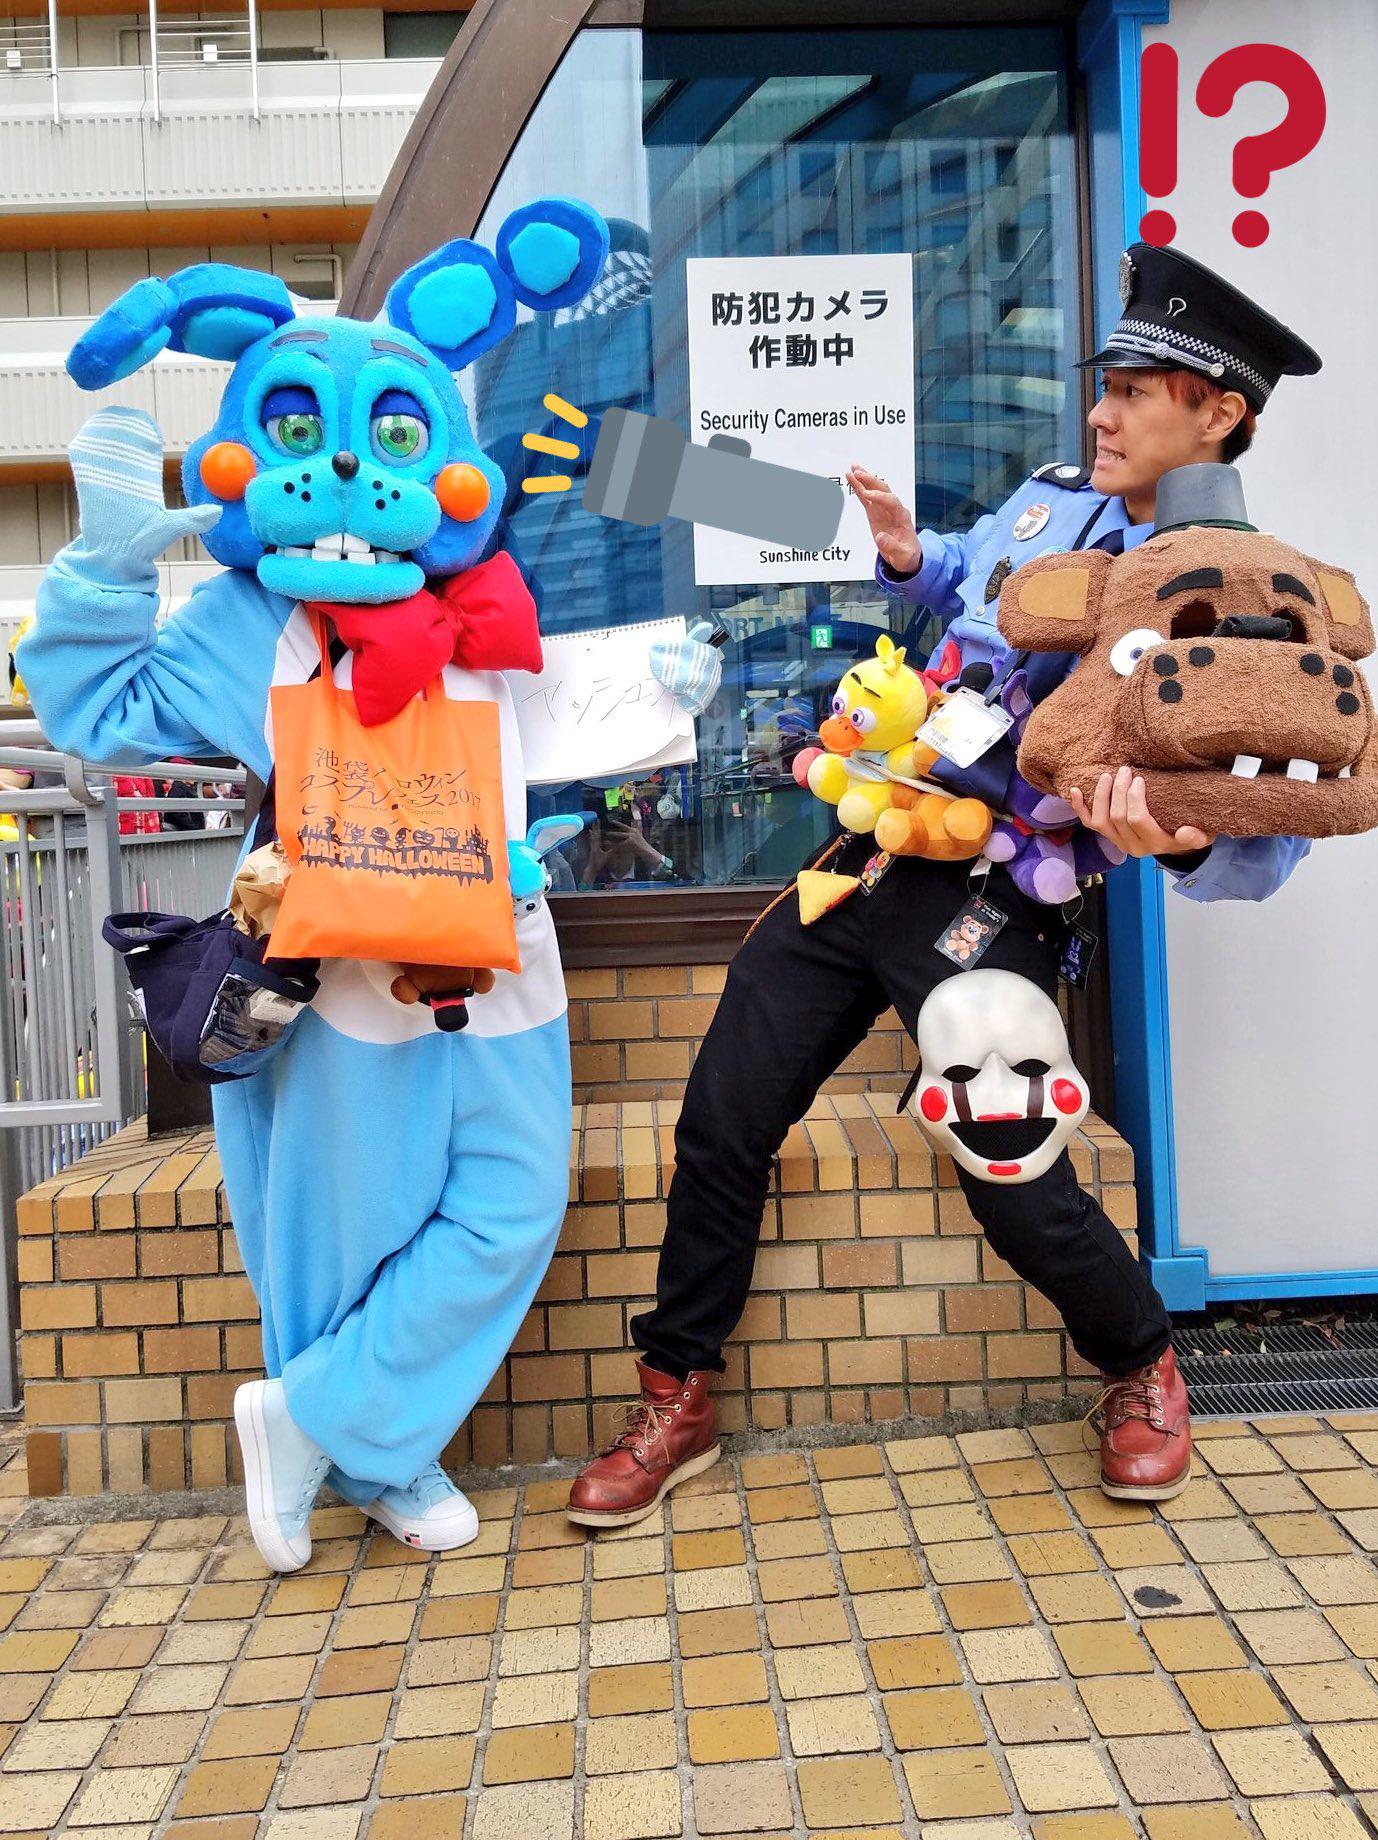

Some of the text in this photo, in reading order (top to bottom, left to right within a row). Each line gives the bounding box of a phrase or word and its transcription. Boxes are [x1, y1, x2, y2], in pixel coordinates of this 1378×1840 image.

[711, 289, 889, 327] 防犯カメラ
[749, 332, 854, 369] 作動中
[700, 404, 906, 434] Security Cameras in Use
[759, 546, 851, 564] Sunshine City
[302, 836, 485, 875] HAPPY HALLOWEEN
